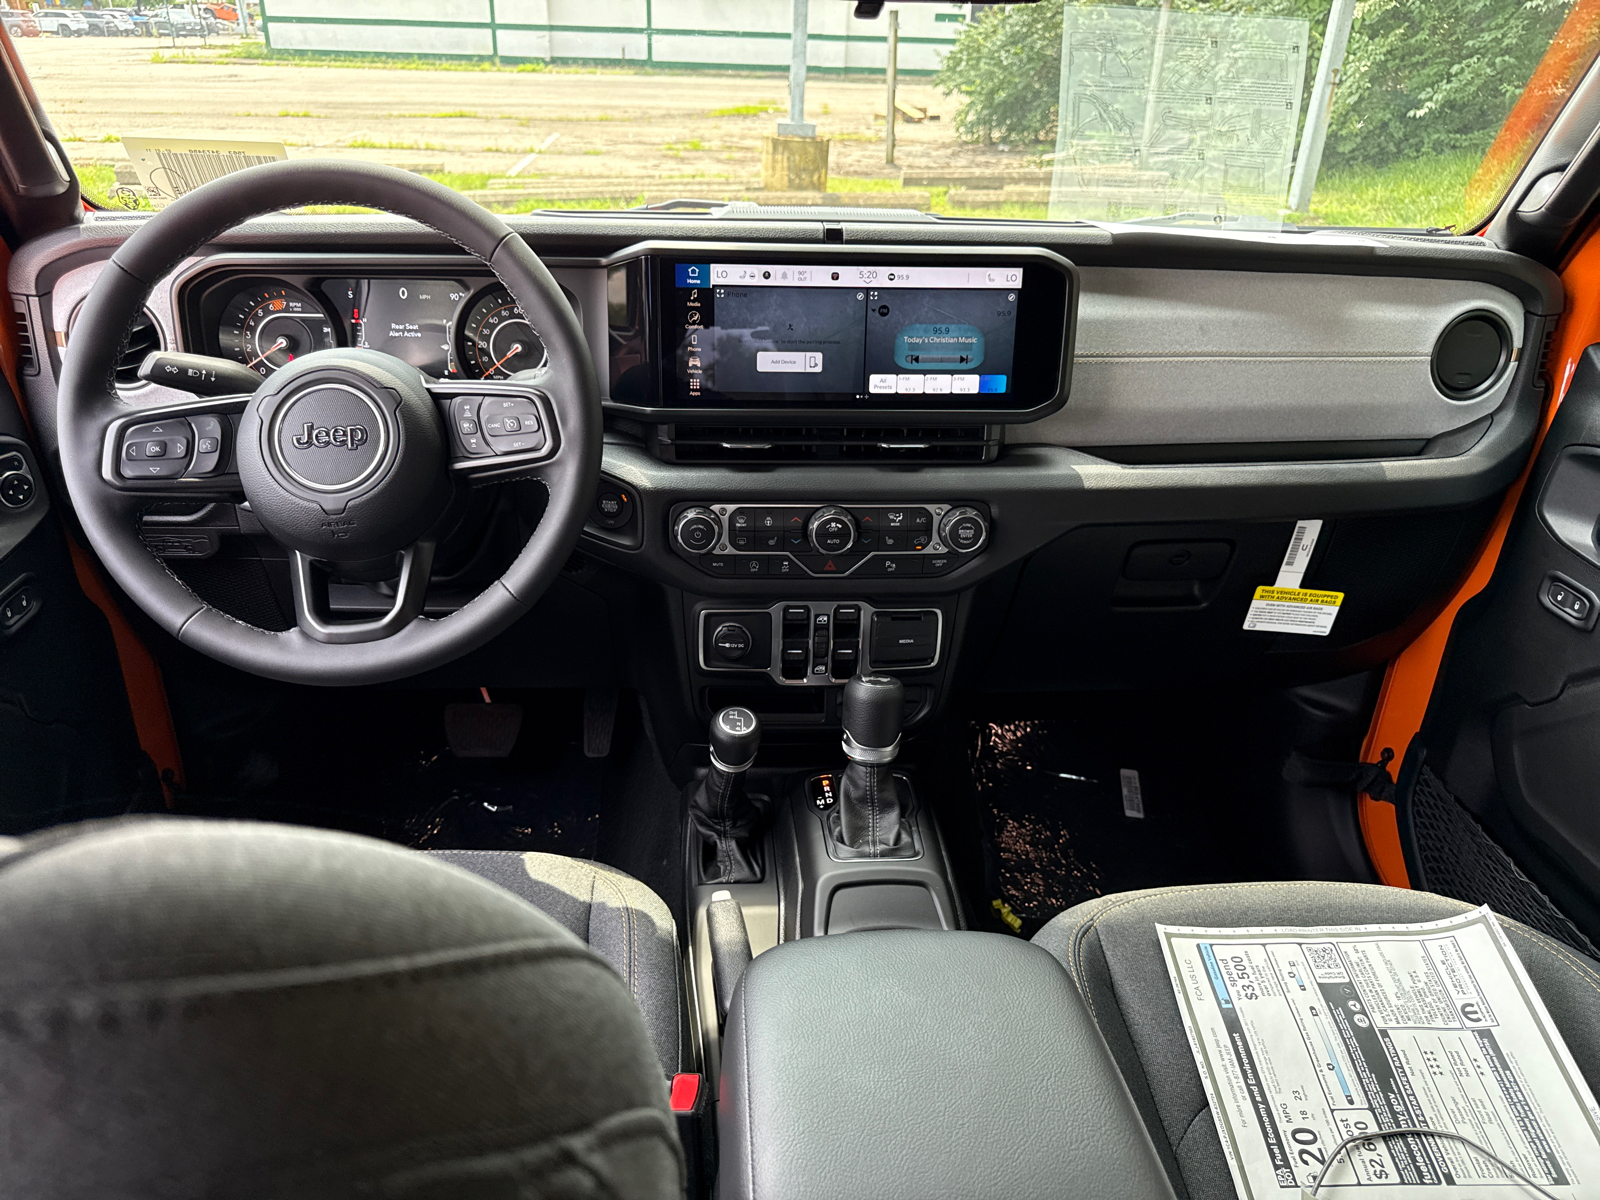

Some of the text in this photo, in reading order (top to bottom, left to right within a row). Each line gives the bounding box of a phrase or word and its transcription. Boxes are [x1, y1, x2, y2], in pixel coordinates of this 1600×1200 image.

[716, 270, 728, 279] LO
[858, 270, 878, 280] 5:20
[1006, 274, 1018, 282] LO
[399, 287, 407, 299] 0
[904, 336, 928, 344] Today's
[932, 327, 950, 335] 95.9
[292, 422, 368, 451] Jeep
[1243, 950, 1252, 964] costs
[1183, 958, 1204, 1000] FCA US LLC
[1218, 958, 1239, 987] spend
[1229, 955, 1261, 1000] $3,500
[1248, 965, 1257, 975] fuel
[1254, 964, 1265, 978] years
[1437, 944, 1467, 995] PROTECTION
[1439, 959, 1461, 995] VEHICLE
[1256, 982, 1266, 996] more
[1262, 984, 1271, 996] over
[1230, 1032, 1256, 1083] Environment
[1382, 1037, 1426, 1120] 5-STAR SAFETY RATINGS
[1447, 1050, 1487, 1124] Front seat Not Rated
[1453, 1050, 1494, 1124] Rear seat Not Rated
[1225, 1075, 1239, 1103] information
[1236, 1085, 1245, 1094] call
[1249, 1086, 1262, 1101] and
[1291, 1090, 1302, 1100] 23
[1236, 1104, 1244, 1117] more
[1279, 1102, 1294, 1123] MPG
[1298, 1110, 1309, 1120] 18
[1399, 1049, 1461, 1178] Overall Not Rated
[1239, 1118, 1248, 1127] For
[1255, 1103, 1278, 1143] Economy
[1287, 1127, 1328, 1166] 20
[1448, 1108, 1488, 1178] Frontal Driver
[1449, 1096, 1494, 1178] Crash Passenger
[1269, 1145, 1284, 1164] Fuel
[1352, 1144, 1363, 1157] fuel
[1358, 1158, 1373, 1181] Annual
[1520, 1152, 1538, 1177] Rollover
[1274, 1168, 1287, 1186] EPA
[1282, 1167, 1296, 1186] DOT
